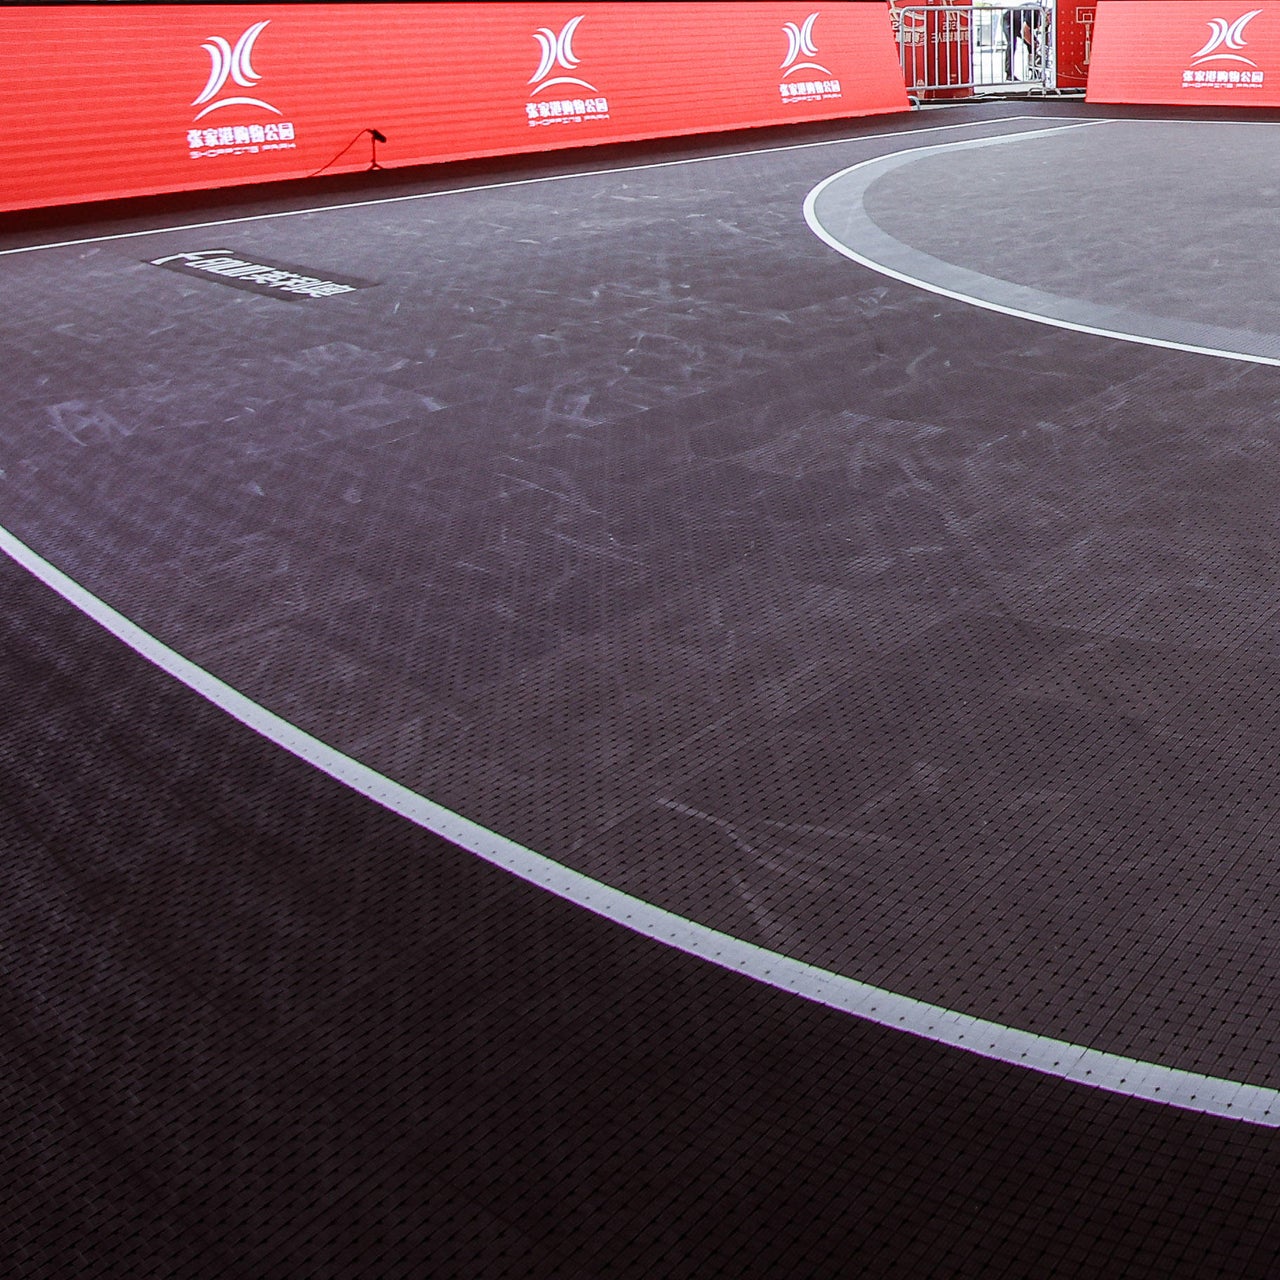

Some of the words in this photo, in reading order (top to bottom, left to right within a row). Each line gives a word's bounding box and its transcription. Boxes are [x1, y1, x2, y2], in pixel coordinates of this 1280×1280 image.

[187, 123, 295, 148] 张家港购物公园
